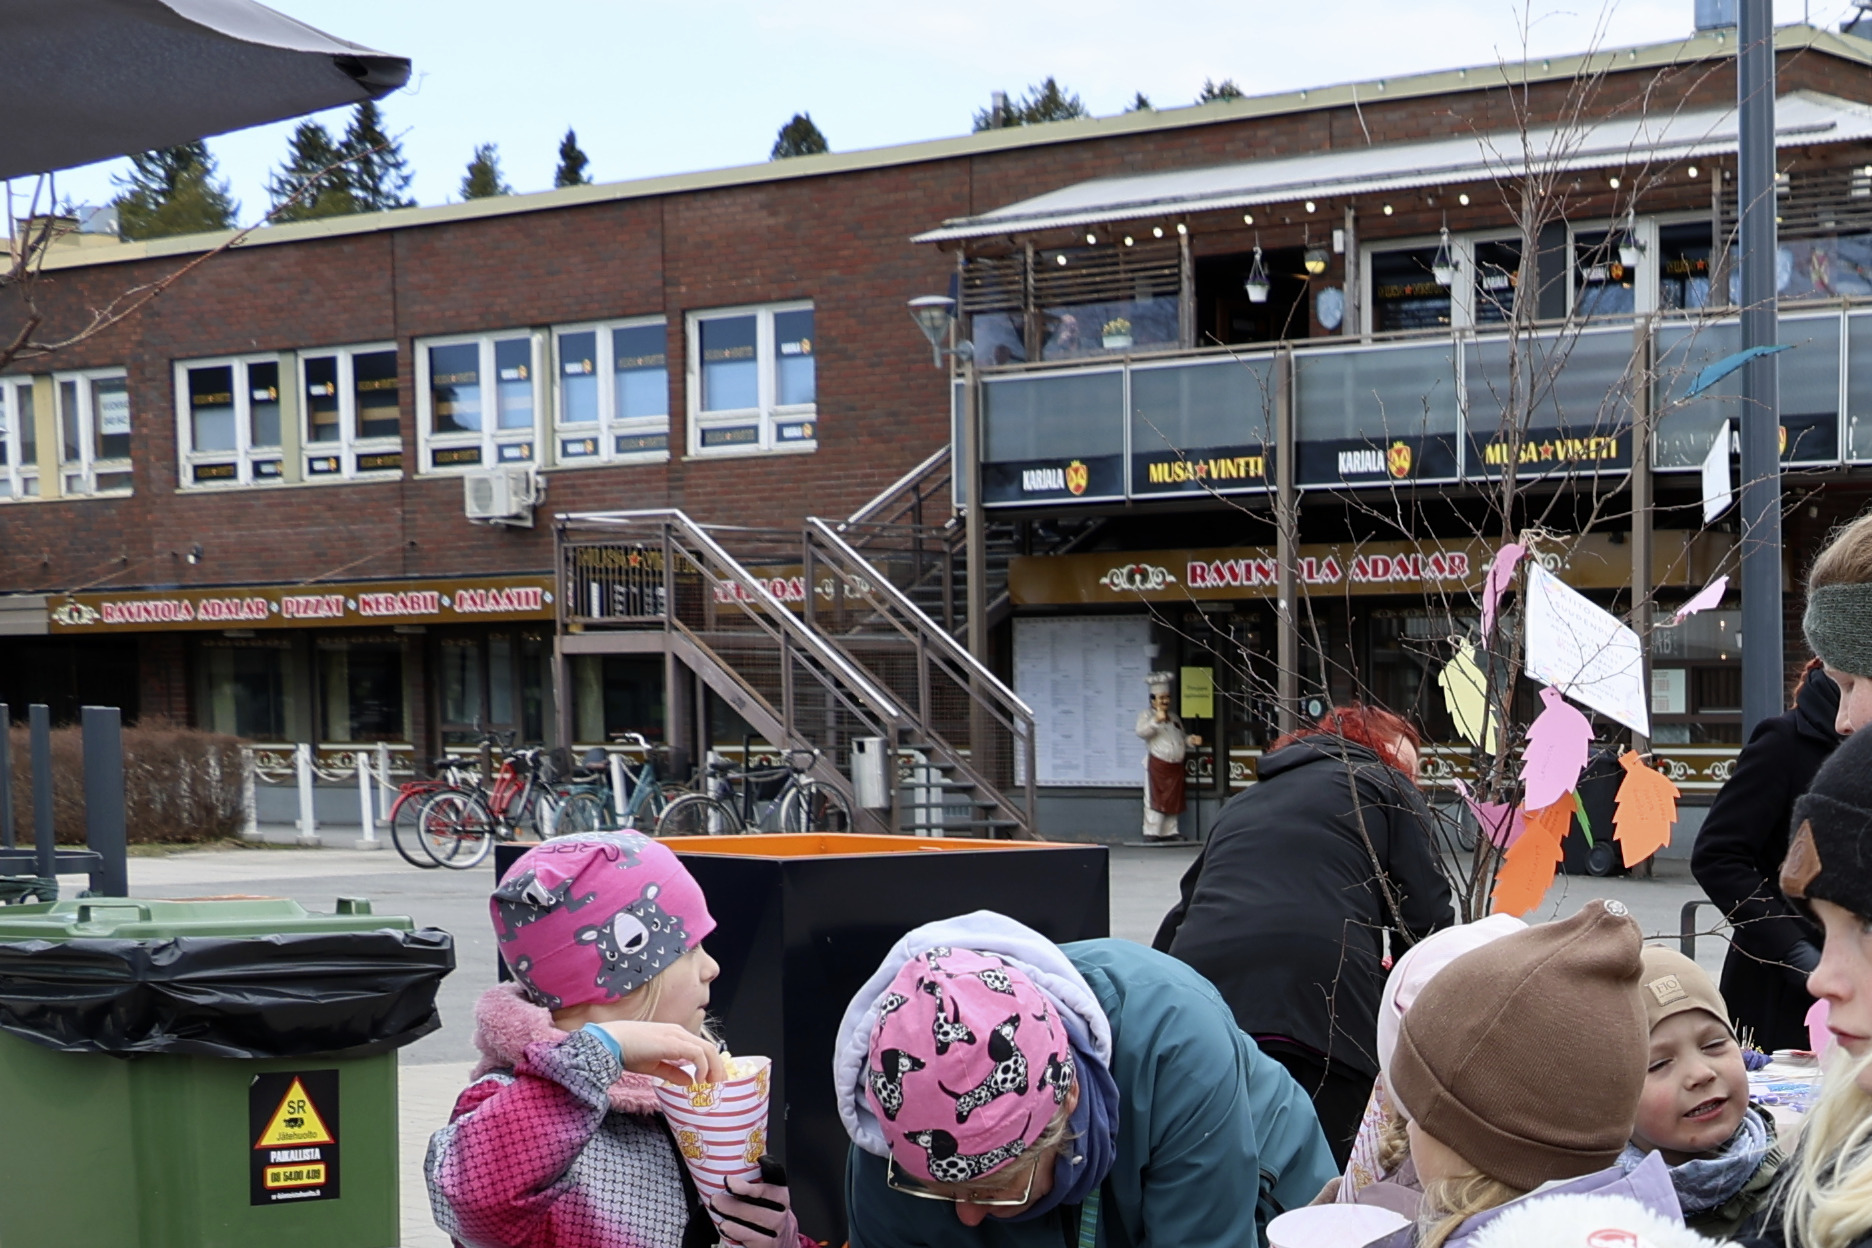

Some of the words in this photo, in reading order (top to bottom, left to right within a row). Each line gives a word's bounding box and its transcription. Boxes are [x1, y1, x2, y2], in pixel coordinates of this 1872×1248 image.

[1149, 463, 1195, 483] MUSA
[1208, 456, 1264, 480] VINTTI
[1338, 449, 1385, 474] KARJALA
[1022, 468, 1065, 491] KARJALA
[1350, 551, 1470, 583] ADALAR
[101, 599, 195, 624] RAVINTOLA
[198, 597, 269, 622] ADALAR
[281, 594, 345, 619] PIZZAT
[358, 590, 441, 616] KEBABIT
[453, 586, 543, 613] SALAATIT
[288, 1100, 307, 1115] SR
[270, 1147, 321, 1163] PAIKALLISTA
